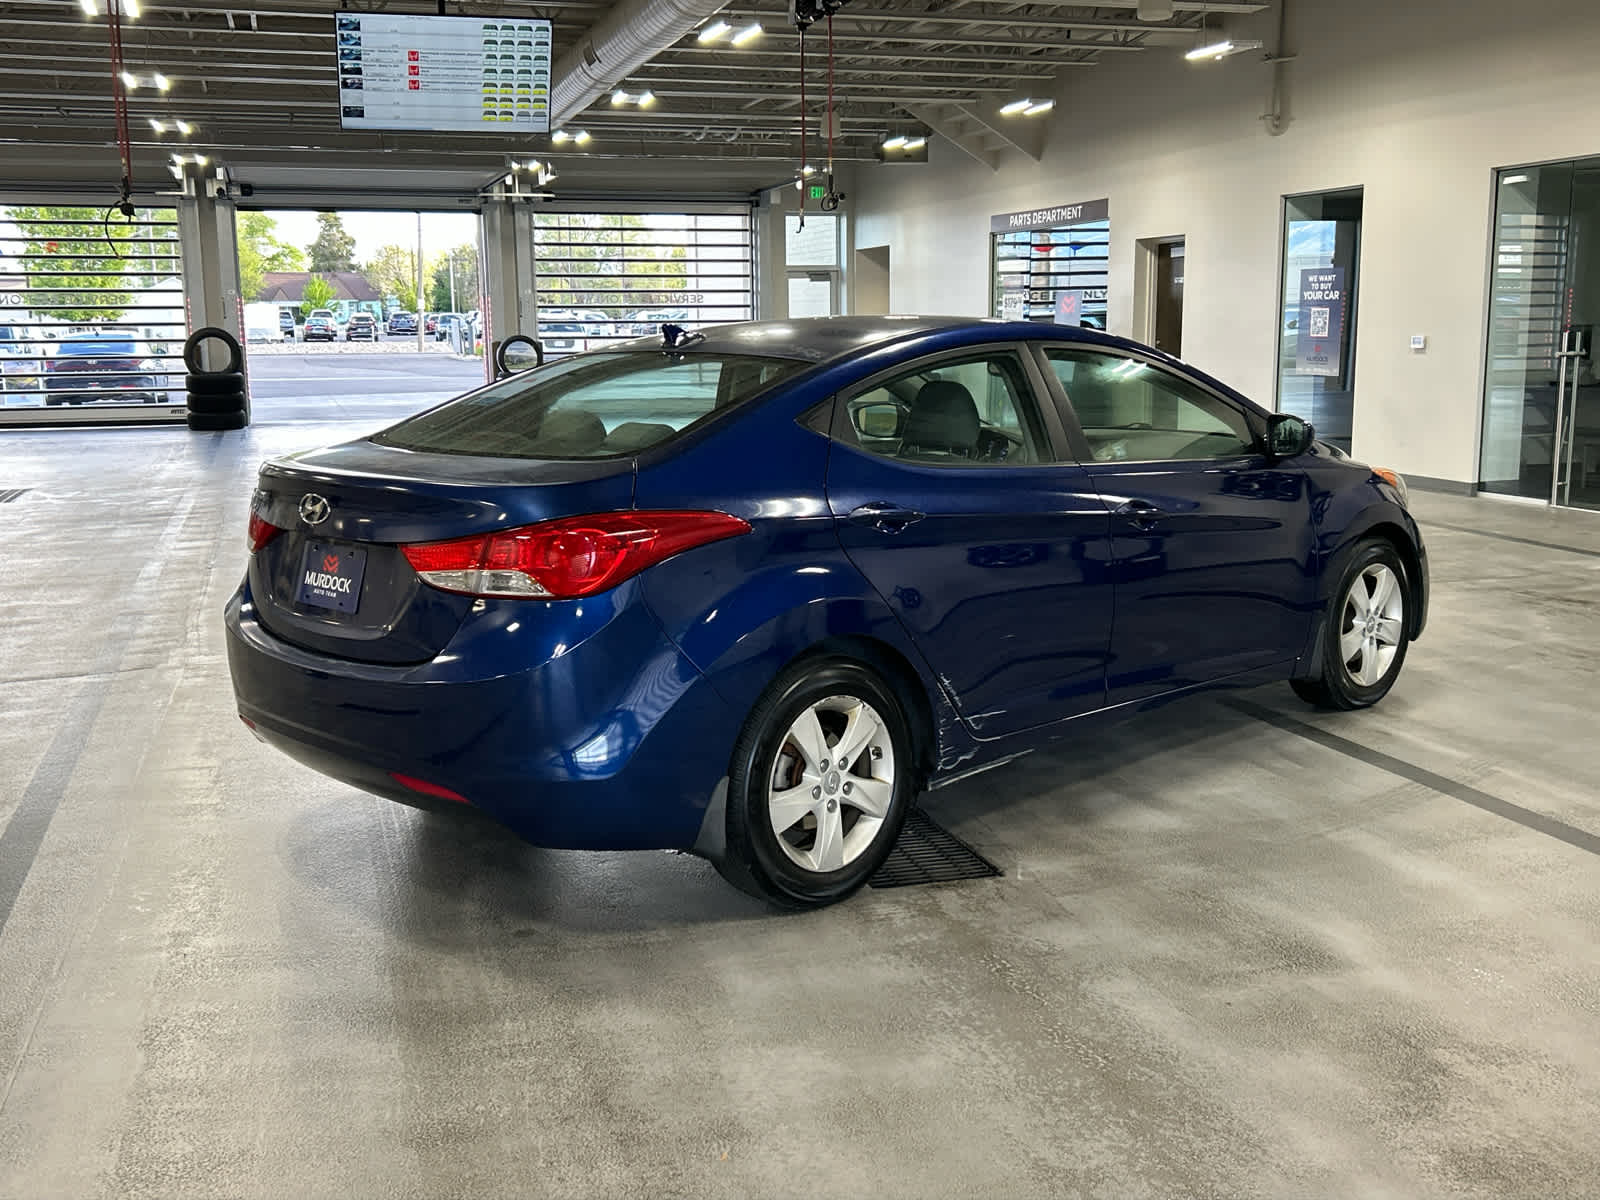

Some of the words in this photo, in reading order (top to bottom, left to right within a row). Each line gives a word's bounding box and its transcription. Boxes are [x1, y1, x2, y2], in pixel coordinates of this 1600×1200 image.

[810, 186, 824, 198] EXIT
[1009, 213, 1031, 227] PARTS
[1032, 205, 1083, 225] DEPARTMENT
[1319, 274, 1336, 282] WANT
[1311, 282, 1320, 290] TO
[1320, 282, 1332, 290] BUY
[1303, 290, 1323, 300] YOUR
[1323, 290, 1340, 300] CAR
[304, 570, 352, 593] MURDOCK
[313, 588, 324, 596] AUTO
